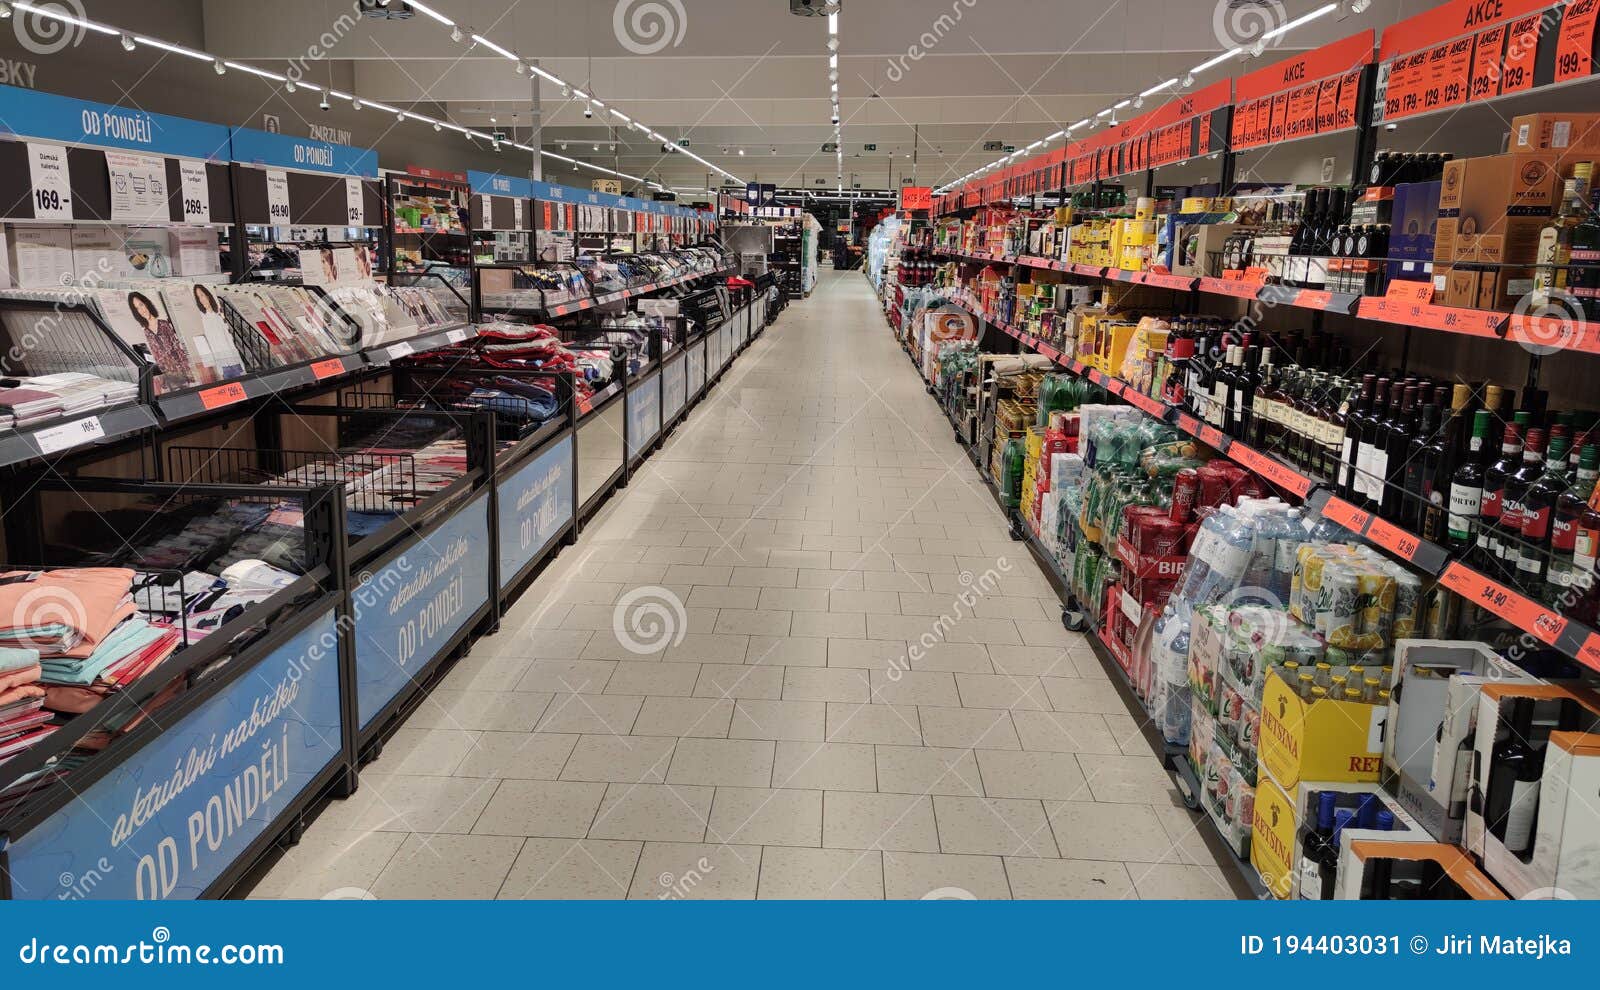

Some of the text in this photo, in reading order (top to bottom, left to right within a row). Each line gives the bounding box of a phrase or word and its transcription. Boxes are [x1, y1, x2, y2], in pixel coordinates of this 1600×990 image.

[1464, 0, 1503, 28] AKCE
[1283, 62, 1305, 82] AKCE
[1559, 52, 1588, 77] 199.-
[1505, 66, 1530, 89] 129.-
[1444, 82, 1465, 103] 129.-
[82, 109, 152, 143] OD PONDĚLÍ
[309, 123, 352, 146] ZMRZLINY
[294, 144, 333, 167] OD PONDĚLÍ
[35, 188, 70, 211] 169.-
[185, 199, 207, 215] 269.-
[271, 204, 289, 217] 49.90
[1481, 585, 1508, 607] 34.90
[399, 567, 464, 666] OD PONDĚLÍ
[1262, 705, 1299, 761] RETSINA
[111, 678, 300, 847] aktuální nabídka
[136, 723, 289, 900] OD PONDĚLÍ
[1254, 807, 1292, 871] RETSINA
